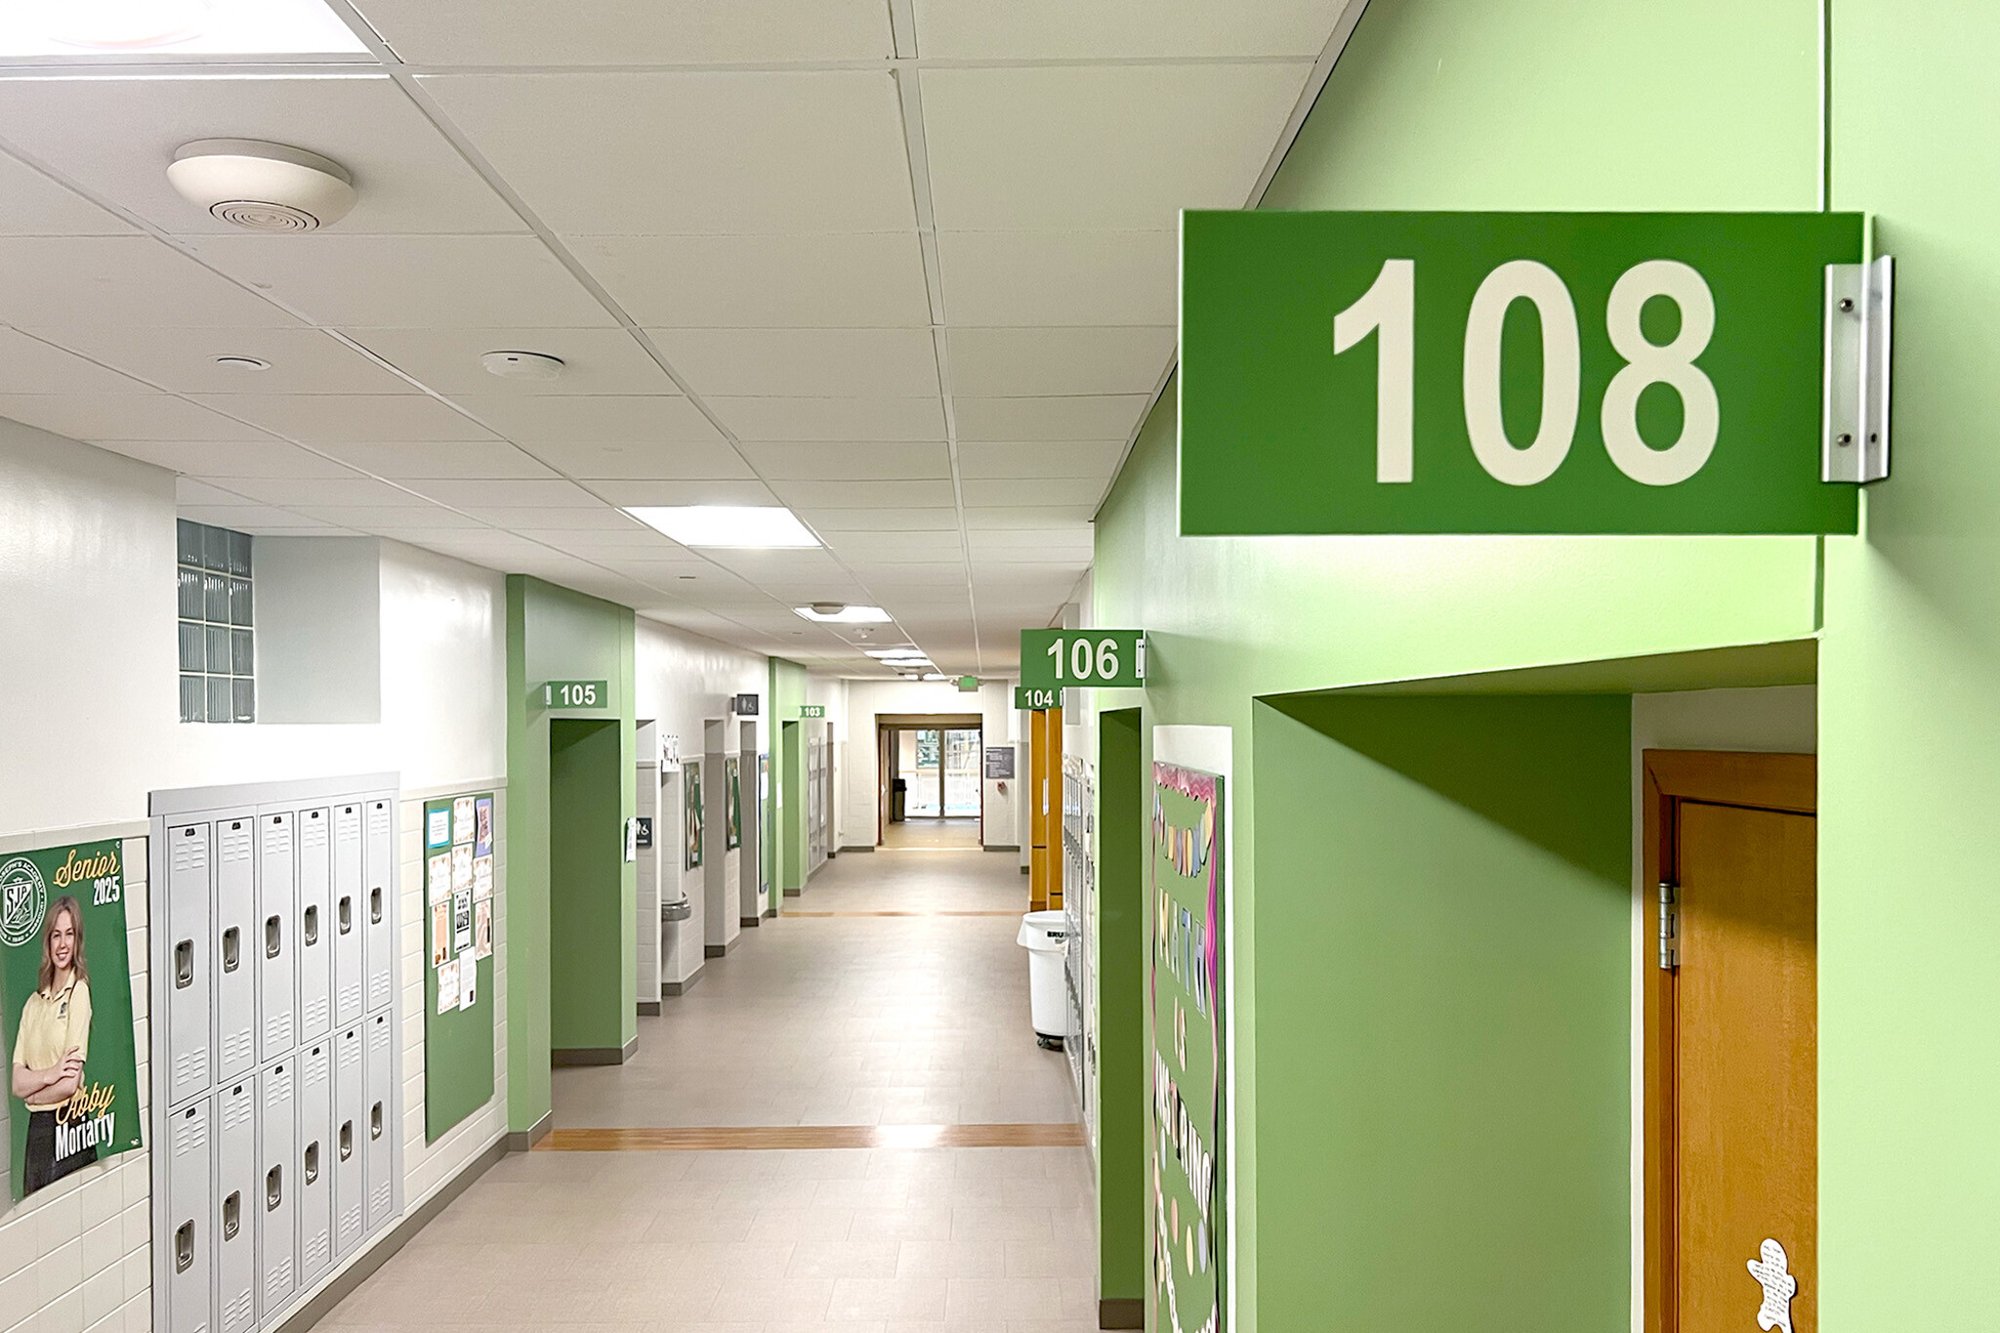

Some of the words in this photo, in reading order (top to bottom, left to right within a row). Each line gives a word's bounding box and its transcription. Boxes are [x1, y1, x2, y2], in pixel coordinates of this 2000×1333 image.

[1333, 259, 1720, 486] 108
[1047, 638, 1119, 680] 106
[560, 684, 596, 706] 105
[805, 707, 820, 717] 103
[1024, 689, 1053, 707] 104
[53, 848, 121, 887] Senior
[93, 875, 120, 906] 2025
[1159, 887, 1207, 1020] MATH
[56, 1081, 115, 1125] Abby
